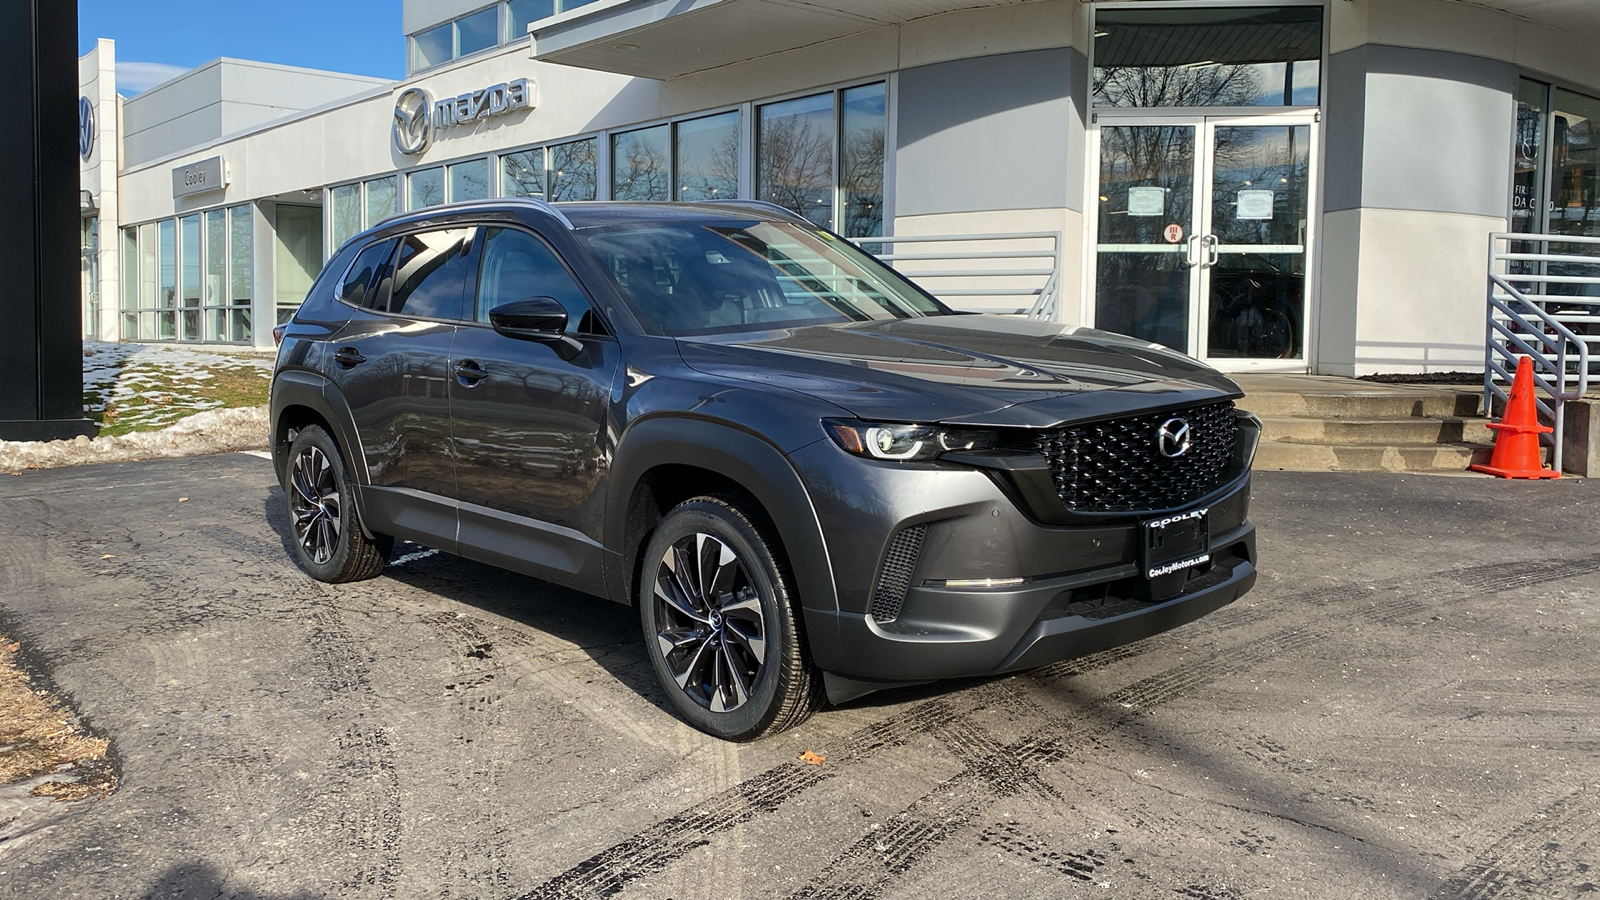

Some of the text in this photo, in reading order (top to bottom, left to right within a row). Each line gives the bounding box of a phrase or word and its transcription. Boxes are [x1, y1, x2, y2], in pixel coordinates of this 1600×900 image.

[434, 78, 531, 129] mazda
[184, 166, 207, 187] Cooley
[1170, 233, 1177, 241] R
[1150, 508, 1209, 528] COOLEY
[1149, 554, 1209, 578] CooleyMotors.com
